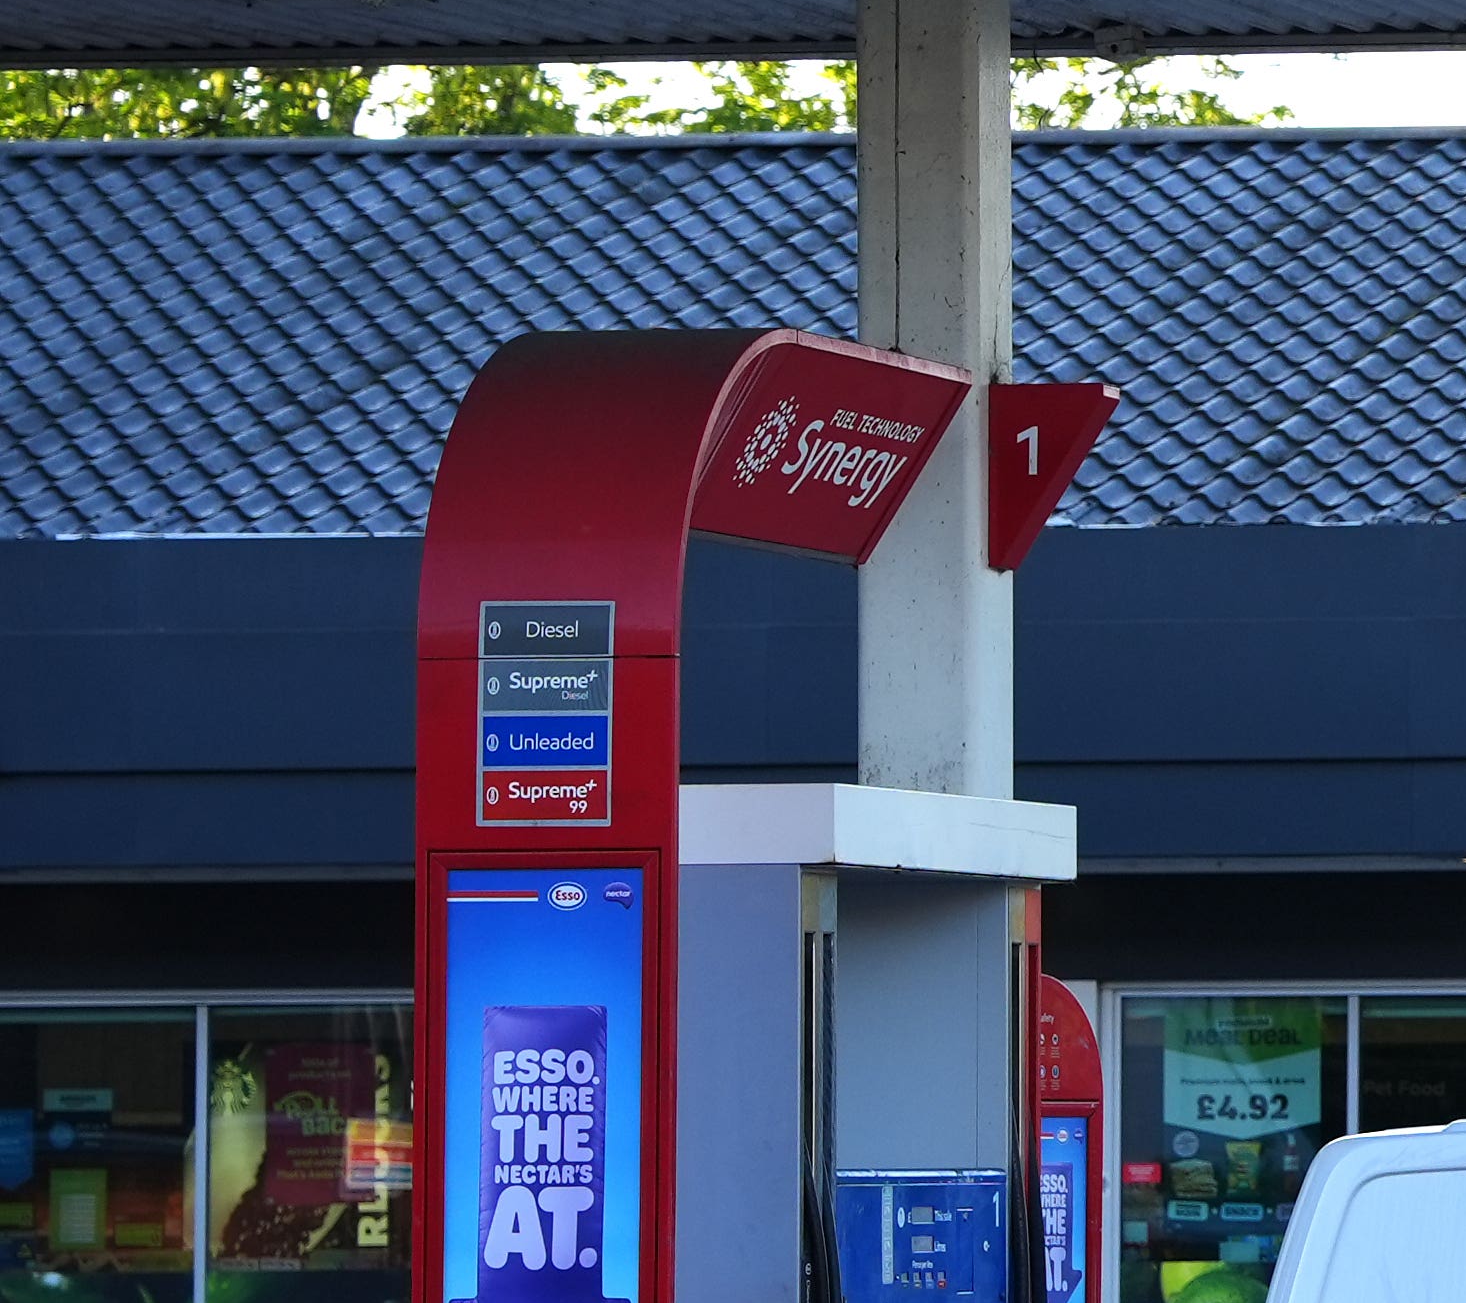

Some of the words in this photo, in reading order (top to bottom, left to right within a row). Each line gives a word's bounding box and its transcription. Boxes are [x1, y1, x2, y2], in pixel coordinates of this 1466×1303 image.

[829, 408, 857, 430] FUEL
[857, 414, 926, 444] TECHNOLOGY
[780, 419, 908, 509] Synergy
[1016, 425, 1040, 476] 1
[526, 620, 580, 638] Diesel
[561, 690, 590, 701] Diesel
[509, 731, 595, 750] Unleaded
[568, 800, 589, 814] 99
[493, 1048, 600, 1085] ESSO.
[492, 1085, 595, 1113] WHERE
[1196, 1093, 1289, 1121] £4.92
[490, 1113, 595, 1163] THE
[494, 1164, 594, 1185] NECTAR'S
[1040, 1174, 1068, 1194] SSO.
[992, 1191, 1000, 1228] 1
[483, 1185, 598, 1271] AT.
